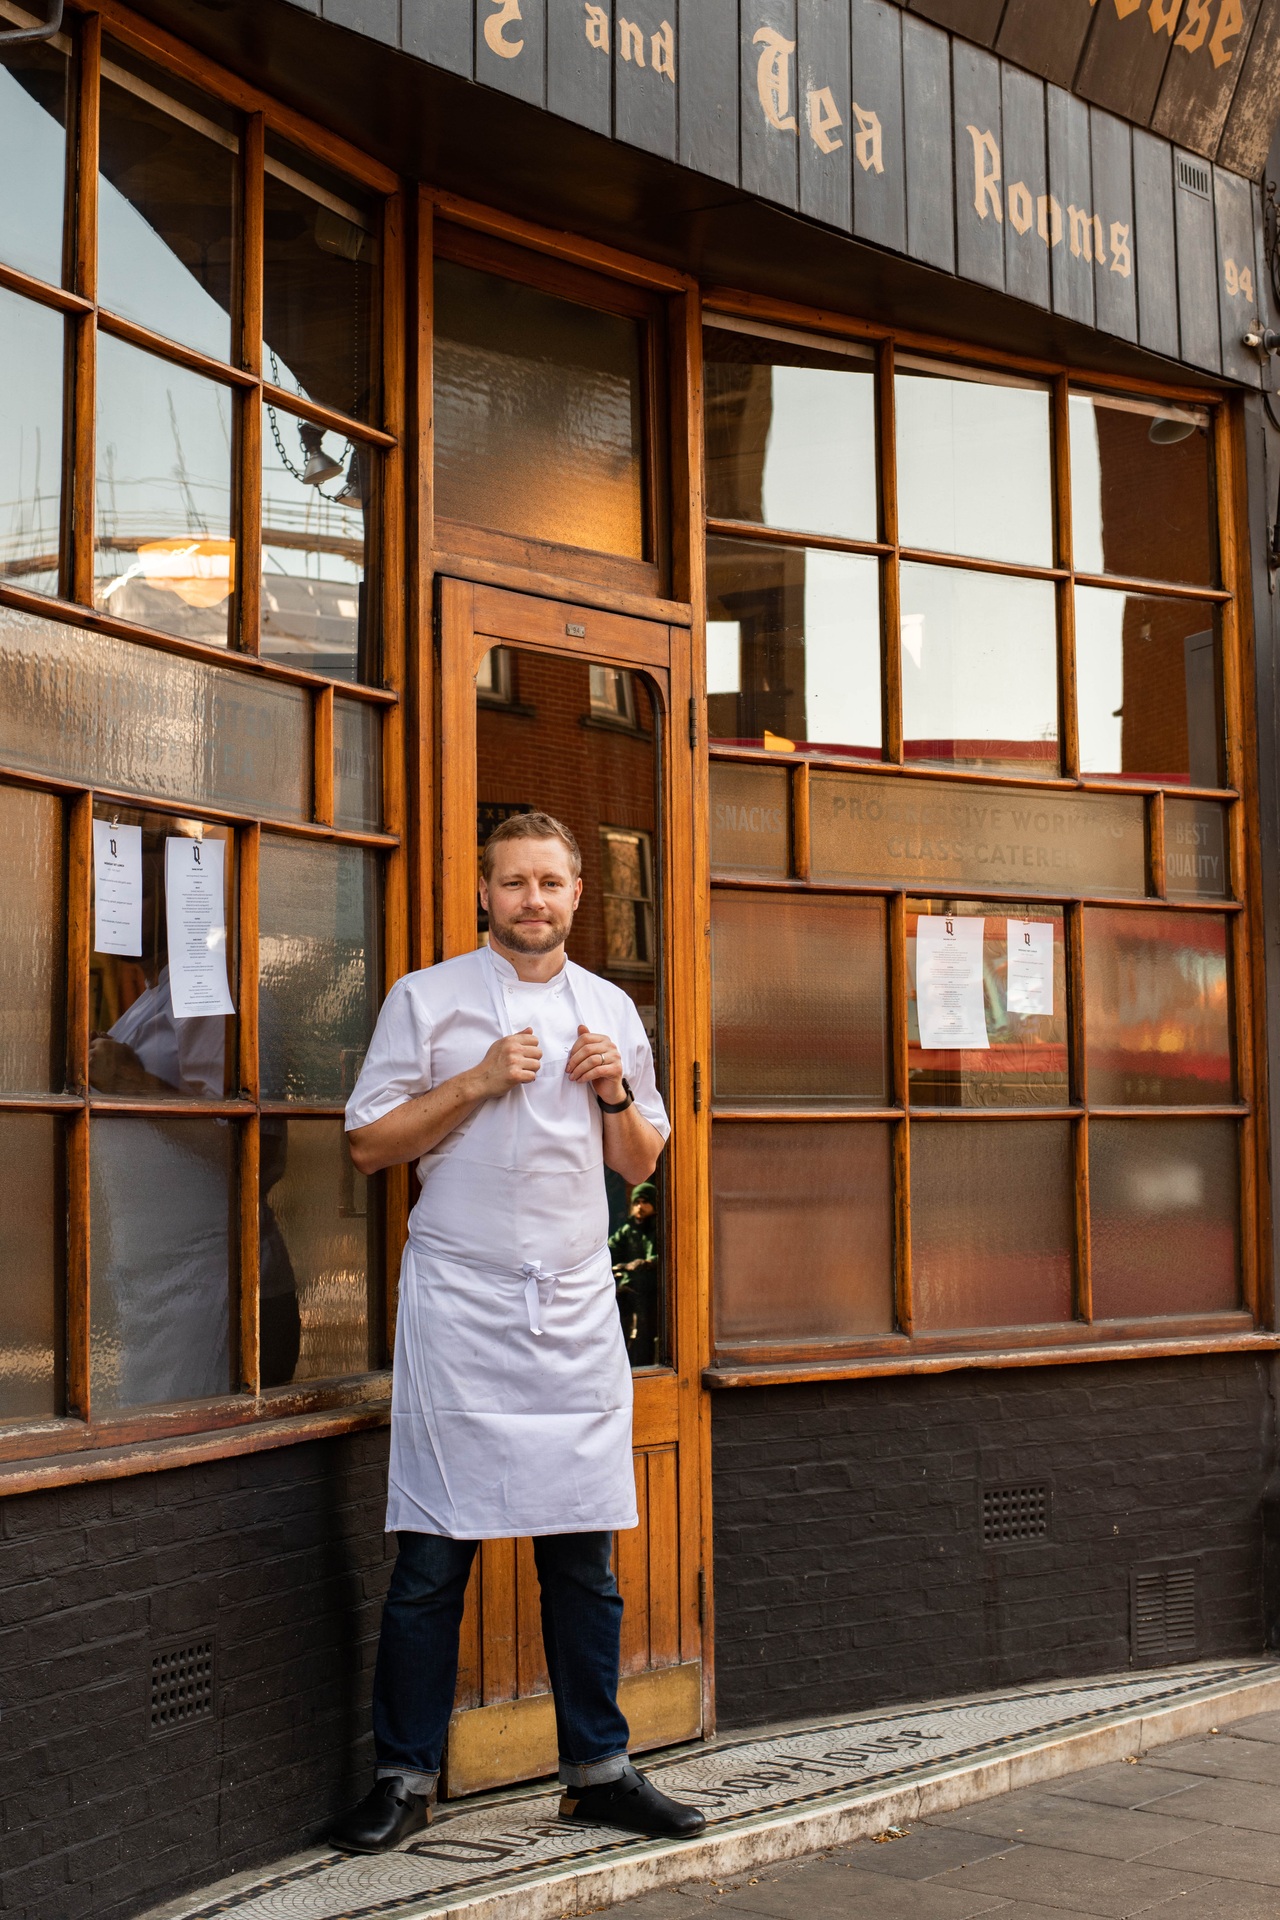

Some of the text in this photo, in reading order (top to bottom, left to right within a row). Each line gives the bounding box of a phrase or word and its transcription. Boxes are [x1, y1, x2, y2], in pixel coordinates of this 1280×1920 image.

[1089, 0, 1244, 70] use
[585, 2, 1132, 278] and Tea Rooms
[1223, 258, 1253, 303] 94
[715, 804, 782, 833] SNACKS
[1175, 822, 1209, 846] BEST
[886, 835, 965, 863] CLASS
[1166, 853, 1219, 879] QUALITY
